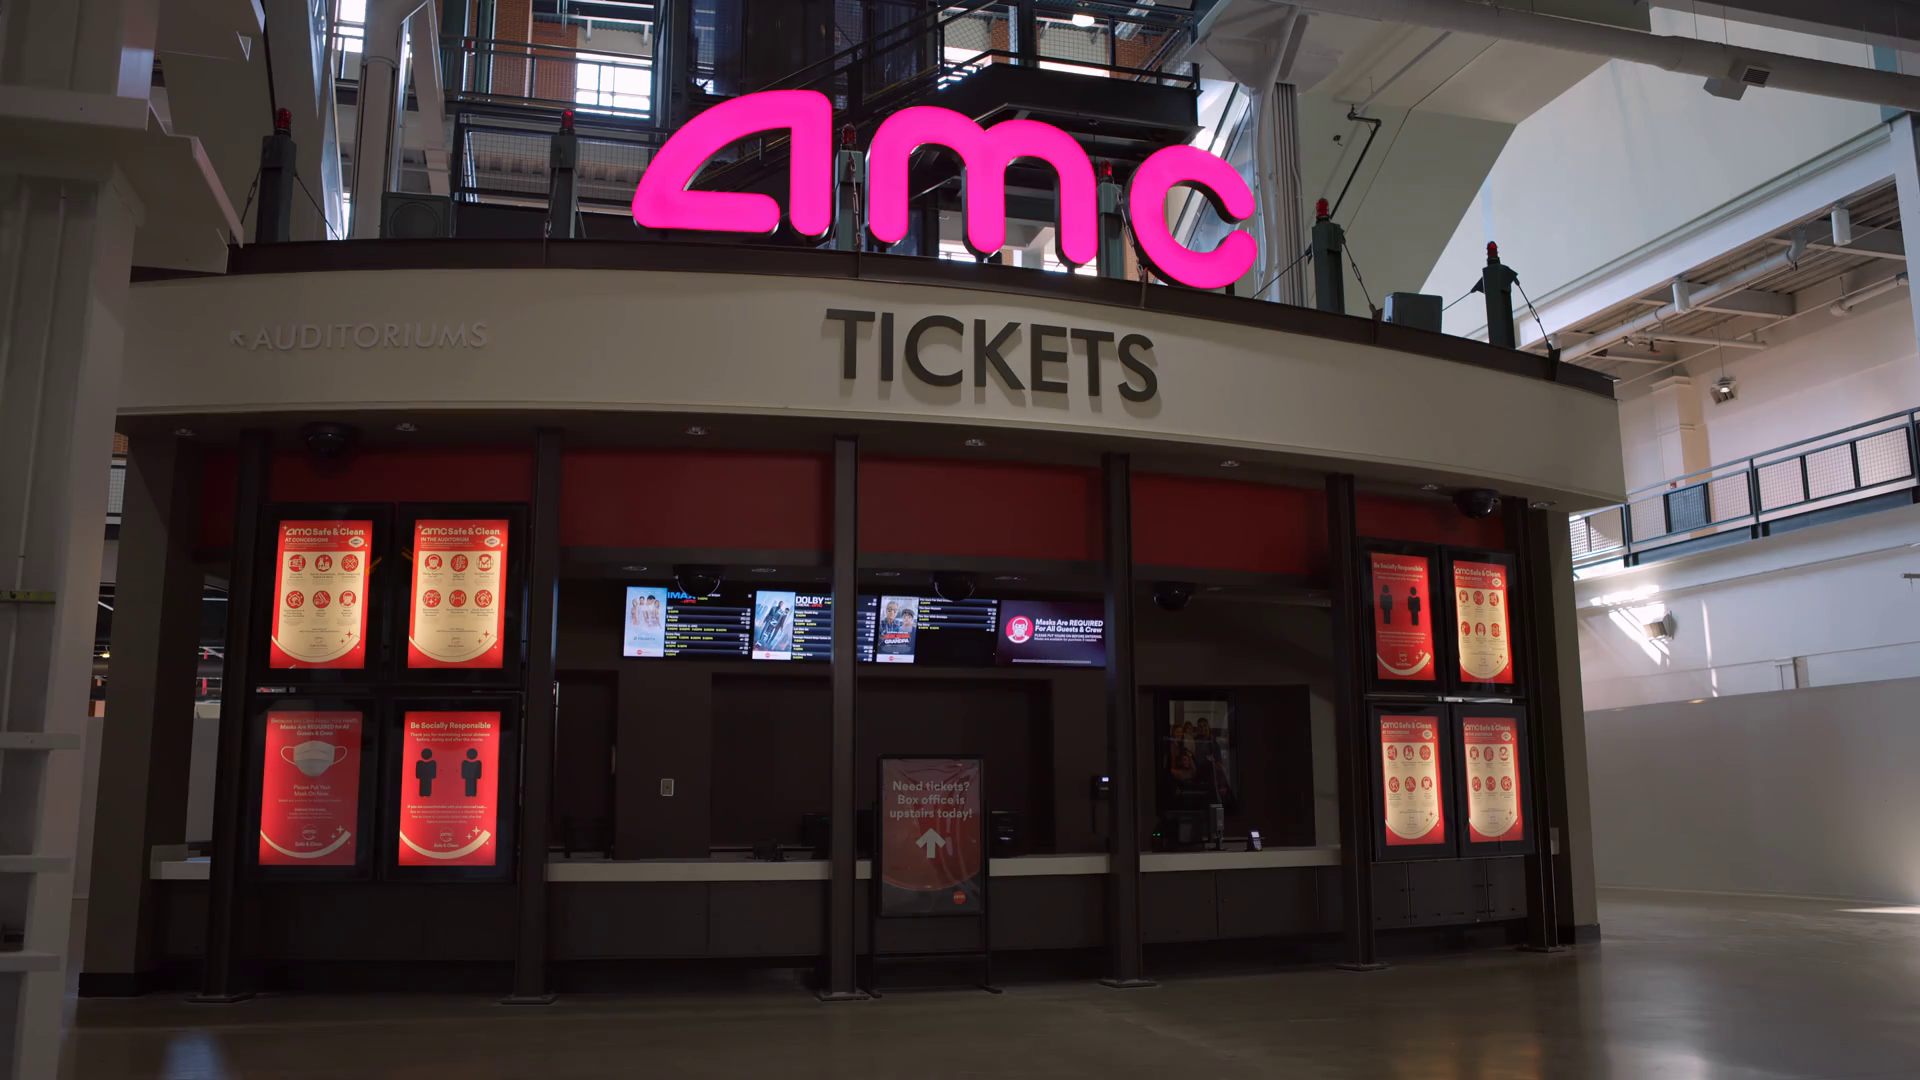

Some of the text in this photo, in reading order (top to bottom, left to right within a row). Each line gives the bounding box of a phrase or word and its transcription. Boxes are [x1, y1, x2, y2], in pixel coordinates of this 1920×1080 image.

[632, 89, 1258, 289] amc
[252, 320, 489, 351] AUDITORIUMS
[826, 308, 1158, 402] TICKETS
[312, 527, 332, 536] Safe
[332, 527, 339, 536] &
[448, 527, 467, 536] Safe
[468, 527, 475, 536] &
[1380, 562, 1397, 571] Socially
[1397, 564, 1423, 572] Responsible
[796, 596, 824, 605] DOLBY
[1035, 618, 1056, 626] Masks
[421, 722, 448, 730] Socially
[449, 722, 491, 730] Responsible
[893, 781, 970, 791] Need tickets?
[898, 794, 965, 805] Box office is
[890, 808, 972, 820] upstairs today!
